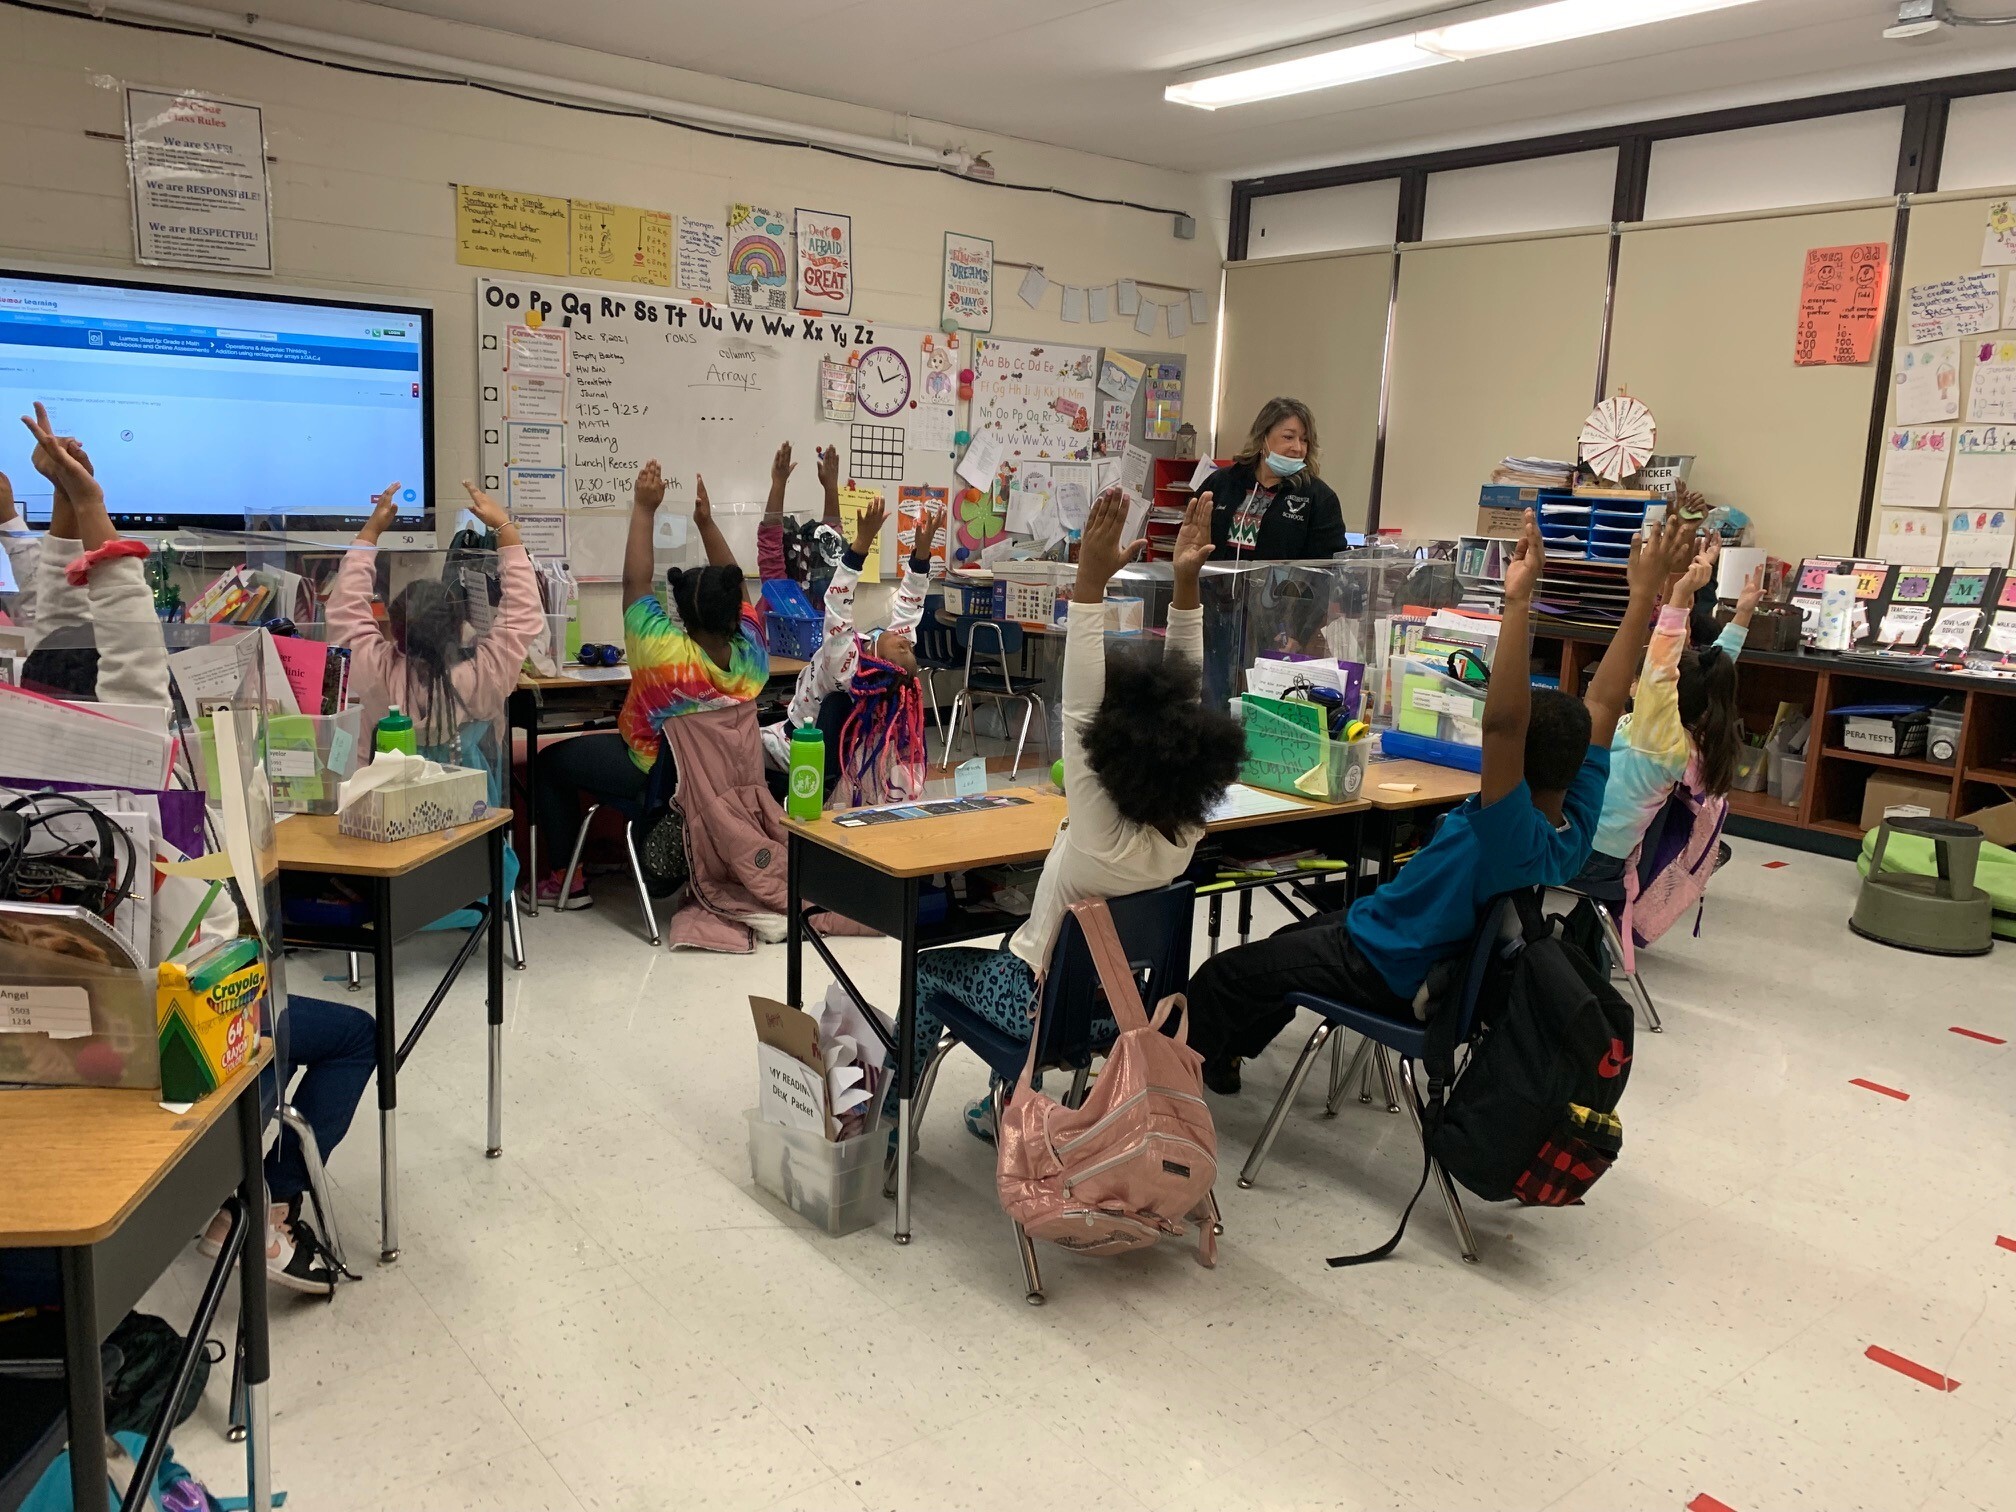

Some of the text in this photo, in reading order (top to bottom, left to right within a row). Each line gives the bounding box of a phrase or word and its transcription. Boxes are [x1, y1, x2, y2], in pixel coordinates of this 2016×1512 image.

[197, 115, 227, 128] Rules
[163, 136, 181, 146] We
[183, 140, 201, 149] are
[146, 180, 260, 201] We are RESPONSIBLE!
[149, 222, 258, 241] We are RESPECTFUL!
[808, 237, 842, 256] AFRAID
[1808, 246, 1881, 265] Even Odd
[803, 266, 847, 290] GREAT
[951, 262, 988, 282] DREAMS
[1968, 272, 1996, 281] numbers
[24, 298, 58, 308] Learning
[960, 296, 977, 307] WAY
[1912, 296, 1959, 310] equations
[530, 291, 552, 321] Pp
[561, 293, 592, 324] Qq
[601, 296, 626, 318] Rr
[634, 300, 658, 323] Ss
[664, 304, 688, 327] Tt
[700, 307, 723, 331] Uu
[730, 311, 753, 333] Vv
[761, 314, 795, 338] Ww
[803, 318, 823, 341] Xx
[830, 324, 847, 348] Yy
[854, 325, 875, 345] Zz
[118, 335, 139, 343] Lumos
[574, 331, 596, 341] Dec.
[664, 332, 697, 344] rows
[109, 341, 142, 350] Workbooks
[173, 345, 210, 354] Assessments
[225, 343, 308, 355] Operations Algebraic Thinking
[215, 348, 238, 356] Addition
[254, 351, 284, 360] rectangular
[283, 353, 300, 361] arrays
[572, 350, 597, 362] Empty
[718, 347, 756, 362] columns
[981, 356, 994, 368] Aa
[997, 356, 1010, 369] Bb
[1028, 360, 1041, 371] Dd
[1043, 361, 1054, 373] Ee
[706, 364, 757, 391] Arrays
[580, 389, 608, 399] Journal
[992, 381, 1005, 398] Gg
[1008, 383, 1021, 394] Hh
[575, 403, 601, 416] 9:15
[980, 406, 992, 418] Nn
[1012, 408, 1023, 423] Pp
[1026, 409, 1039, 424] Qq
[1042, 411, 1052, 421] Rr
[578, 420, 610, 429] MATH
[578, 434, 618, 453] Reading
[1056, 436, 1066, 450] Yy
[1282, 511, 1305, 521] SCHOOL
[1812, 574, 1824, 585] C
[1857, 579, 1871, 591] H
[1907, 582, 1918, 594] A
[1955, 584, 1975, 596] M
[1845, 729, 1894, 744] PERA TESTS
[212, 972, 260, 1002] Crayola
[0, 990, 29, 1002] Angel
[11, 1018, 31, 1026] 1234
[228, 1017, 243, 1046] 64
[769, 1066, 781, 1079] MY
[791, 1096, 814, 1118] Packet
